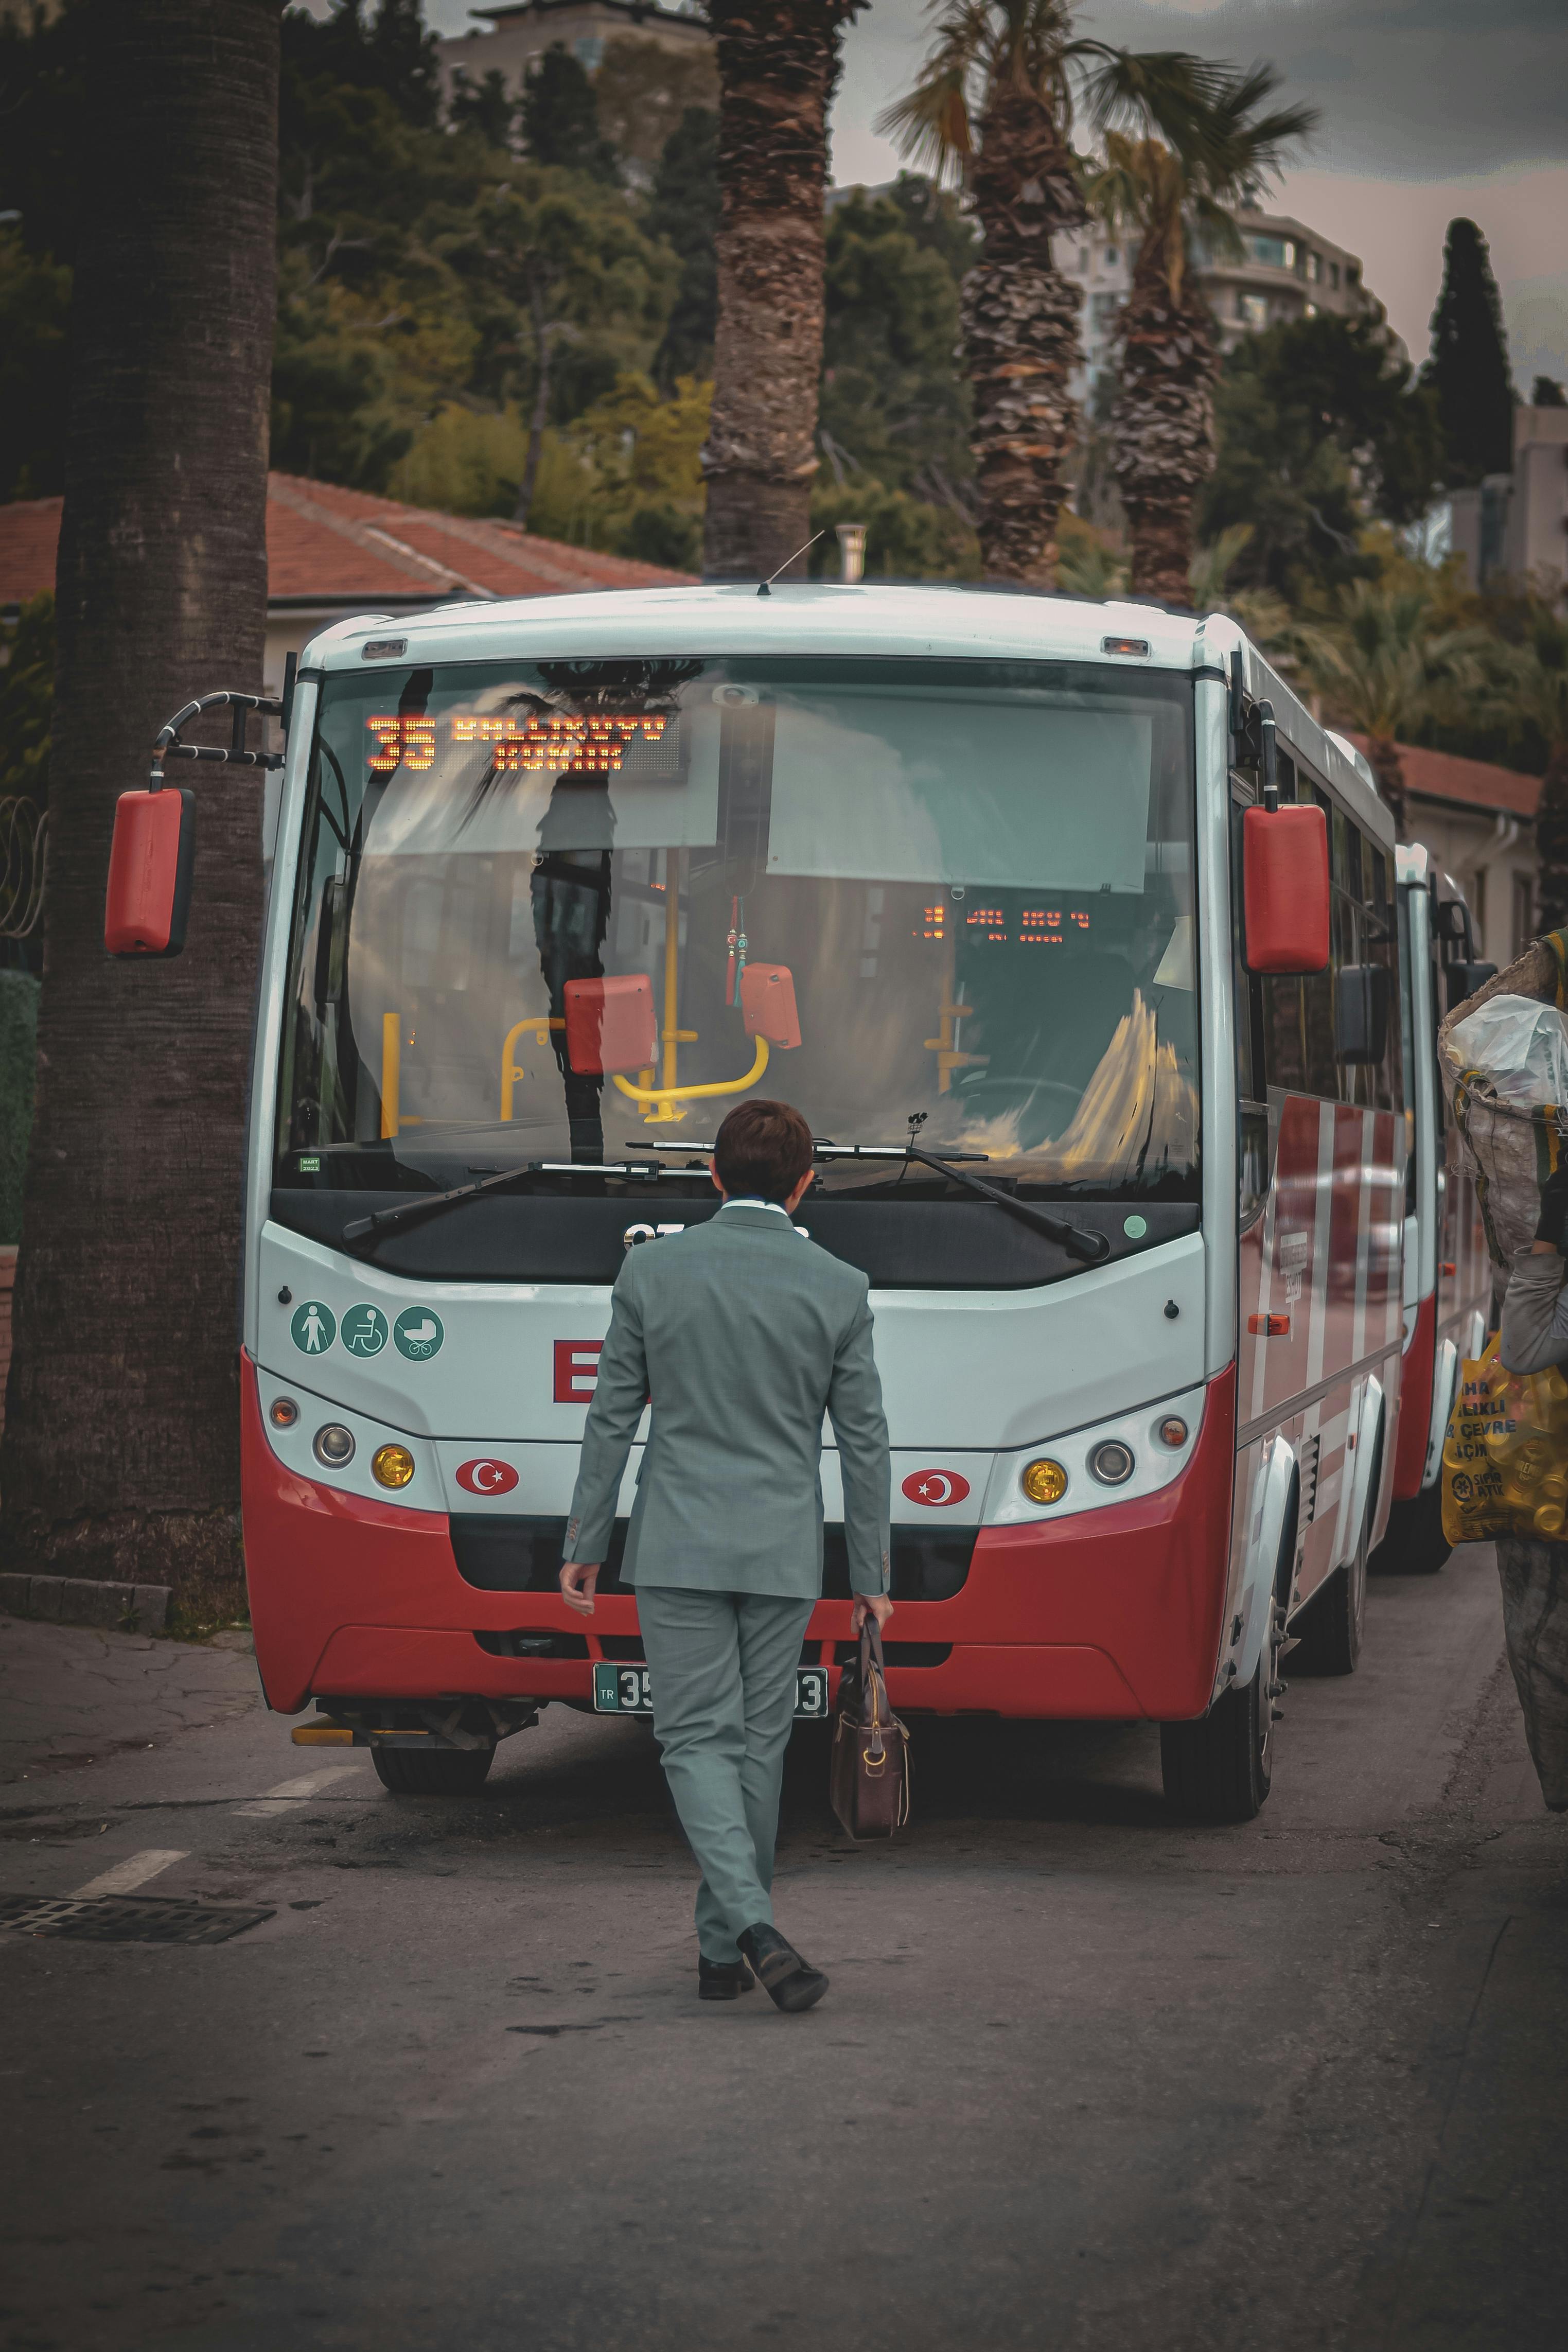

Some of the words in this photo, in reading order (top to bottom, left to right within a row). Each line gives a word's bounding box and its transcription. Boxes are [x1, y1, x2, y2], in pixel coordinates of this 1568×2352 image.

[368, 716, 436, 770] 35
[1462, 1381, 1490, 1396] HA
[1460, 1419, 1516, 1441] ÇEVRE
[600, 1690, 614, 1699] TR
